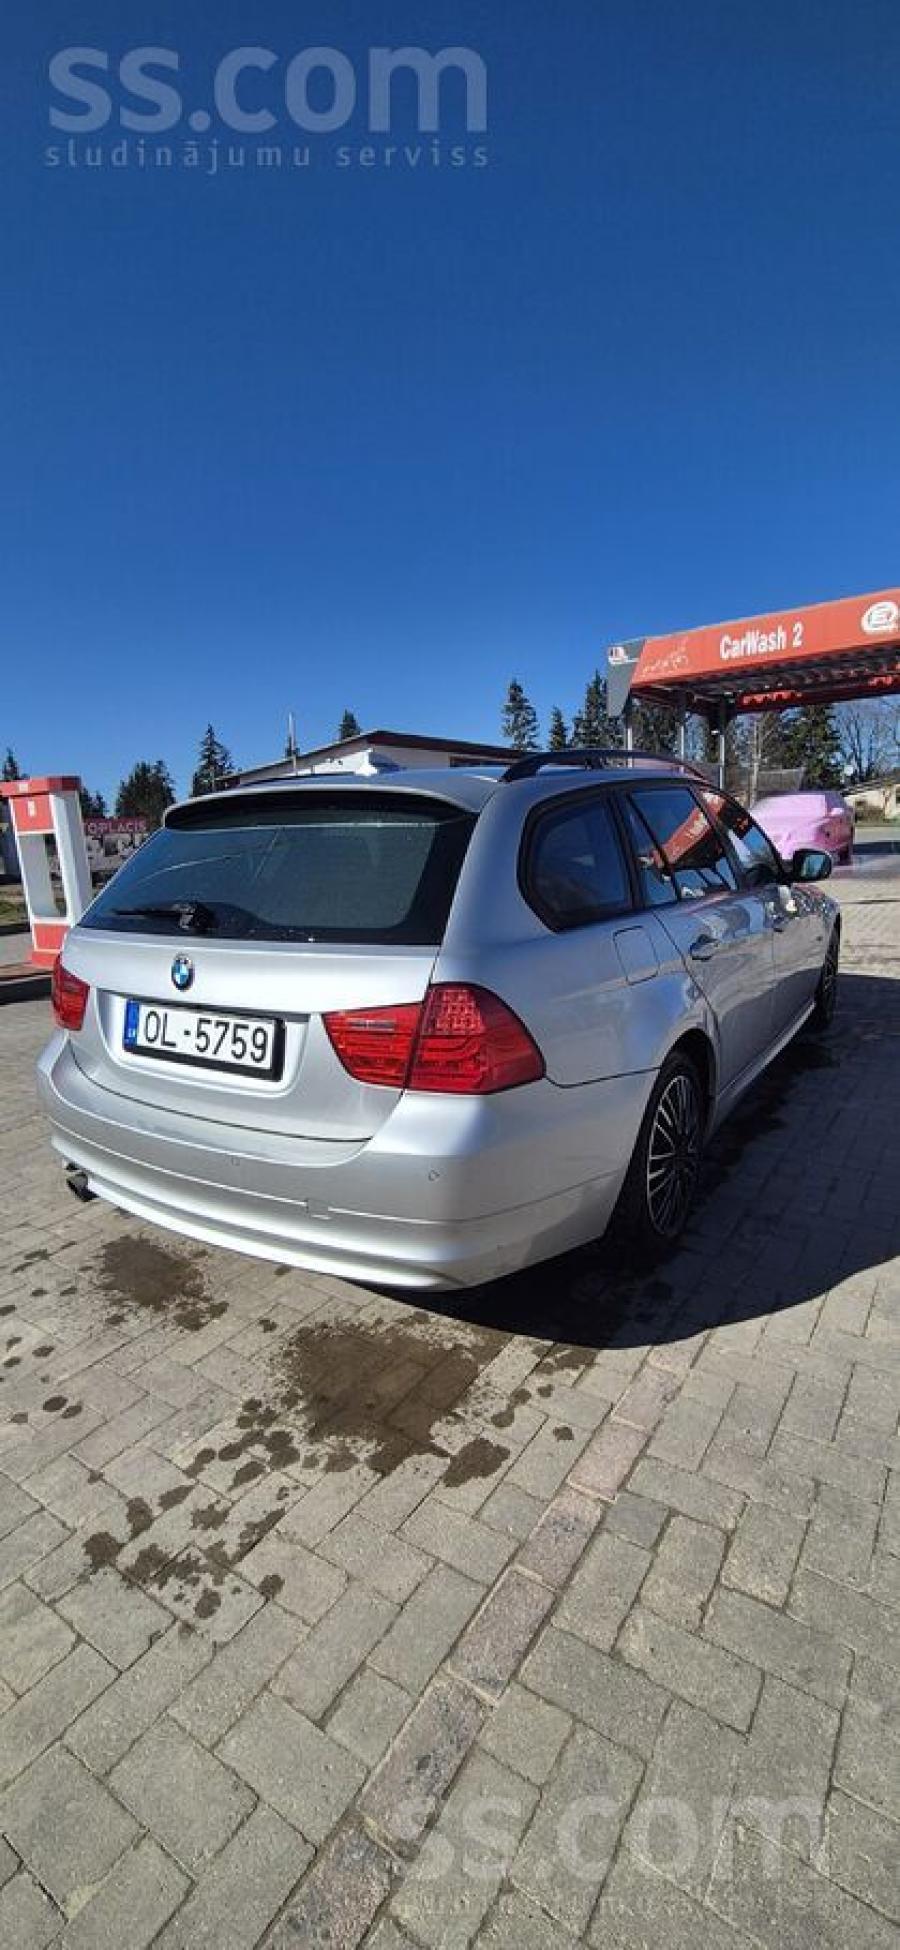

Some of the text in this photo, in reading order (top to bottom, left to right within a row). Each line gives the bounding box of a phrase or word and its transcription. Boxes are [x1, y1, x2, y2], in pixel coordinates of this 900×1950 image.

[720, 622, 804, 660] CarWash 2
[144, 1010, 269, 1063] OL-5759
